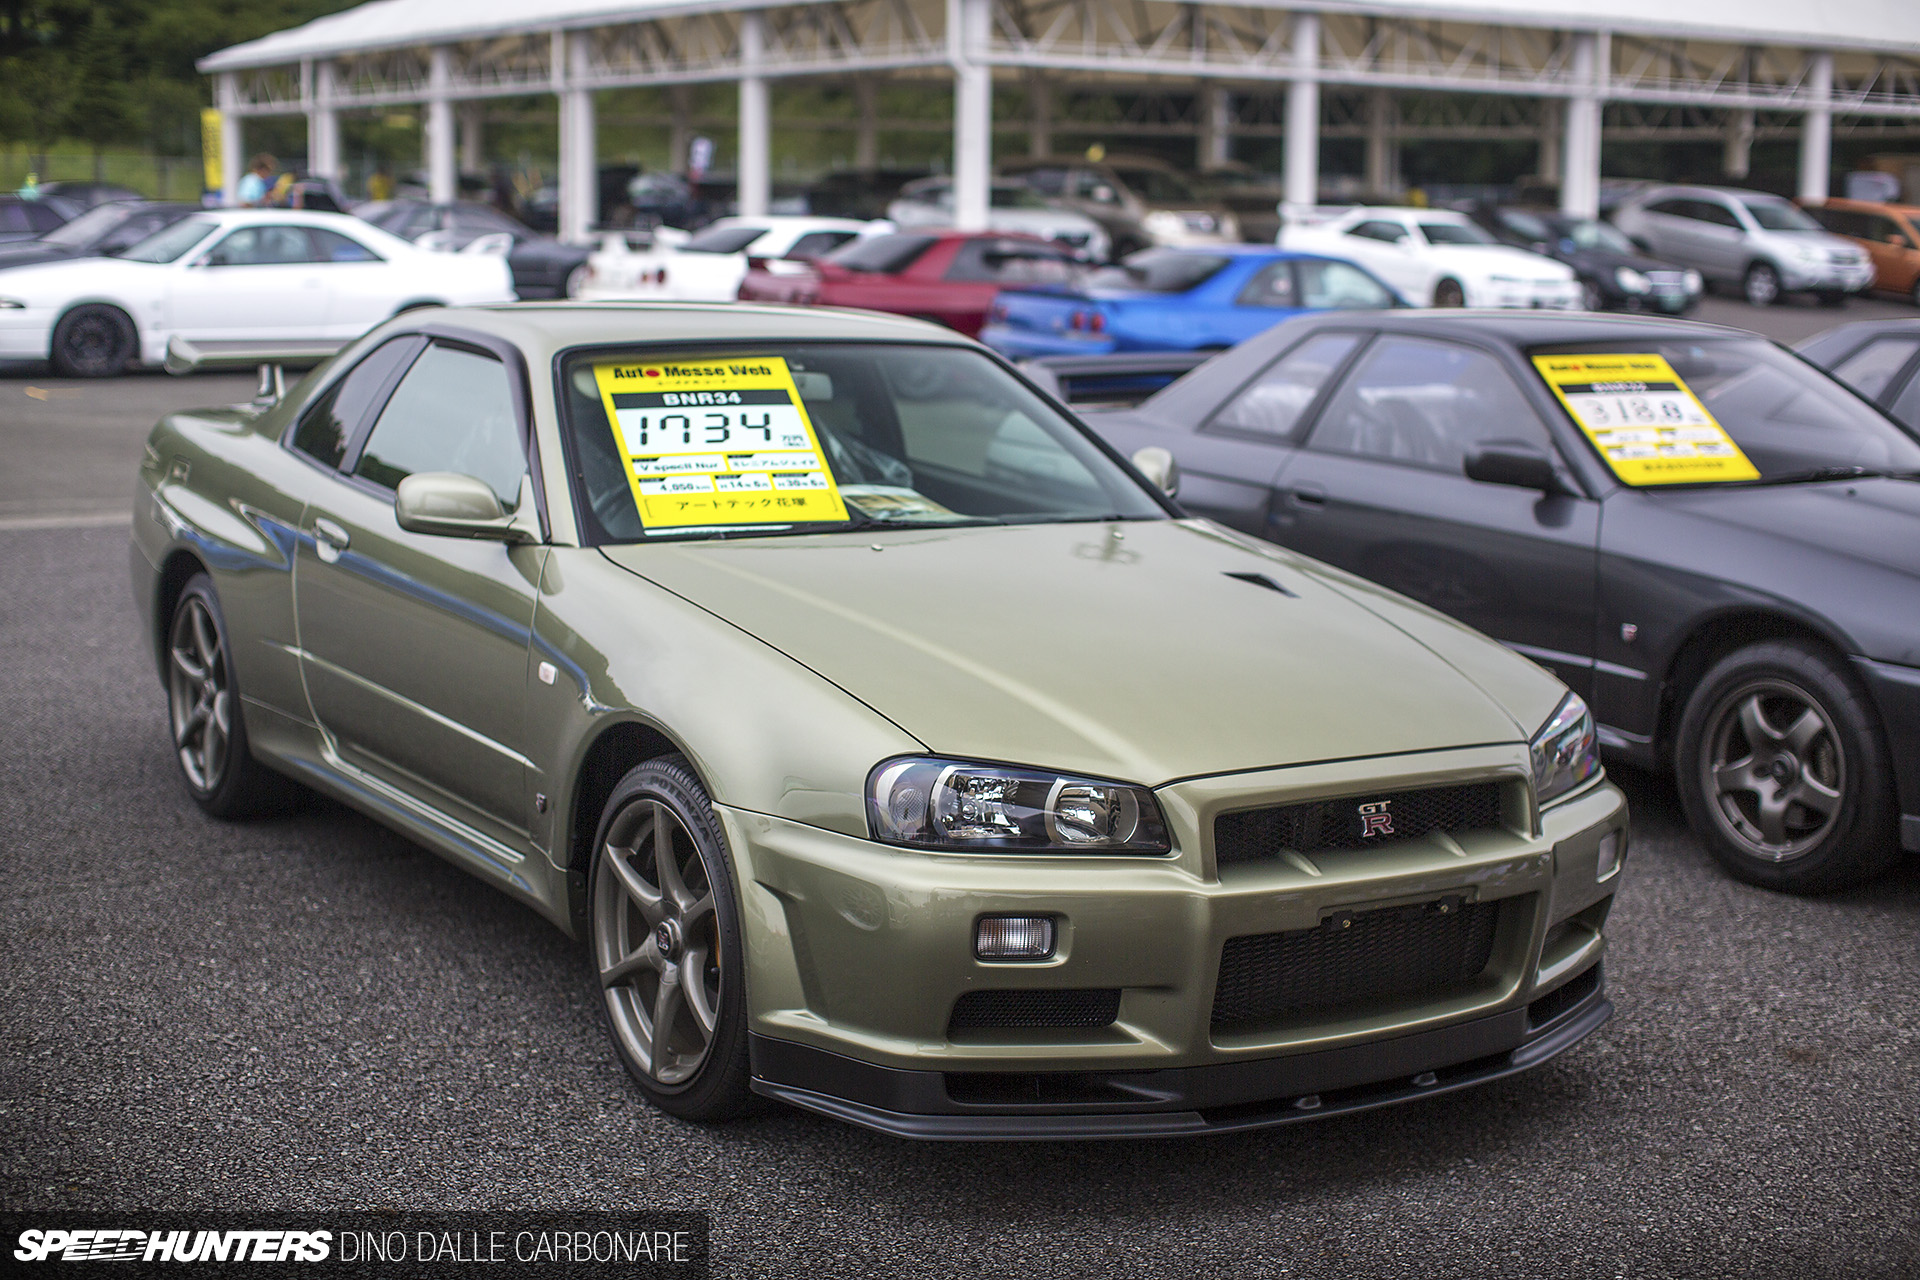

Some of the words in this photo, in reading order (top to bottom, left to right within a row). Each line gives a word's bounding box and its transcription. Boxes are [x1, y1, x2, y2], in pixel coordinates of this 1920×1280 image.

[664, 366, 725, 376] Messe
[728, 364, 772, 375] Web
[662, 391, 742, 407] BNR34
[641, 413, 771, 445] 1734
[1359, 800, 1392, 814] GT
[1361, 812, 1395, 838] R
